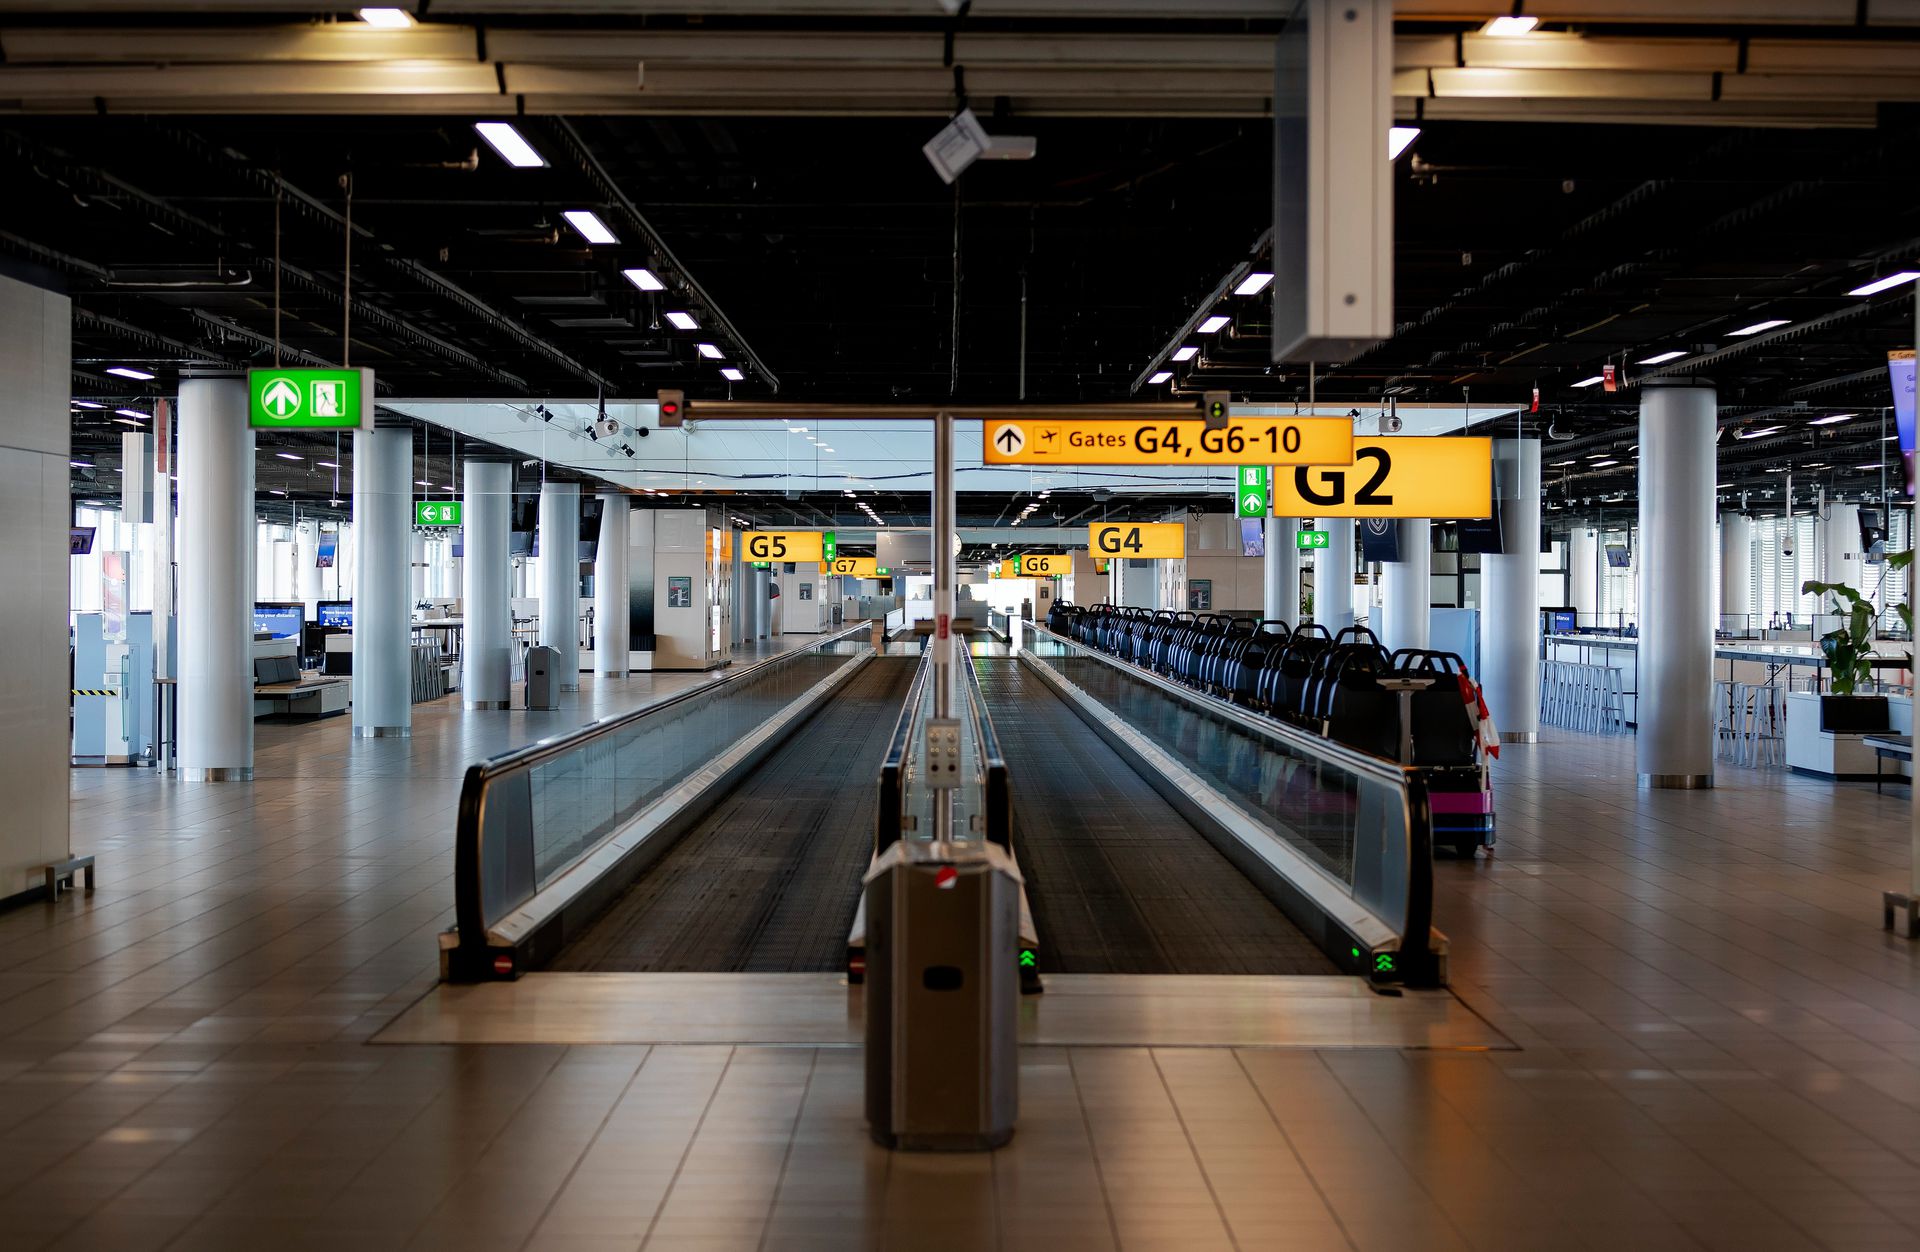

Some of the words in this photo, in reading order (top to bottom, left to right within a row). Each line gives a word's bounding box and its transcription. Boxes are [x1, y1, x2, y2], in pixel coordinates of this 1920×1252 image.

[1070, 431, 1125, 447] Gates
[1134, 426, 1193, 458] G4,
[1200, 425, 1301, 454] G6-10
[1295, 447, 1393, 506] G2
[750, 536, 787, 558] G5
[1098, 527, 1143, 553] G4
[836, 559, 856, 573] G7
[1026, 557, 1049, 571] G6
